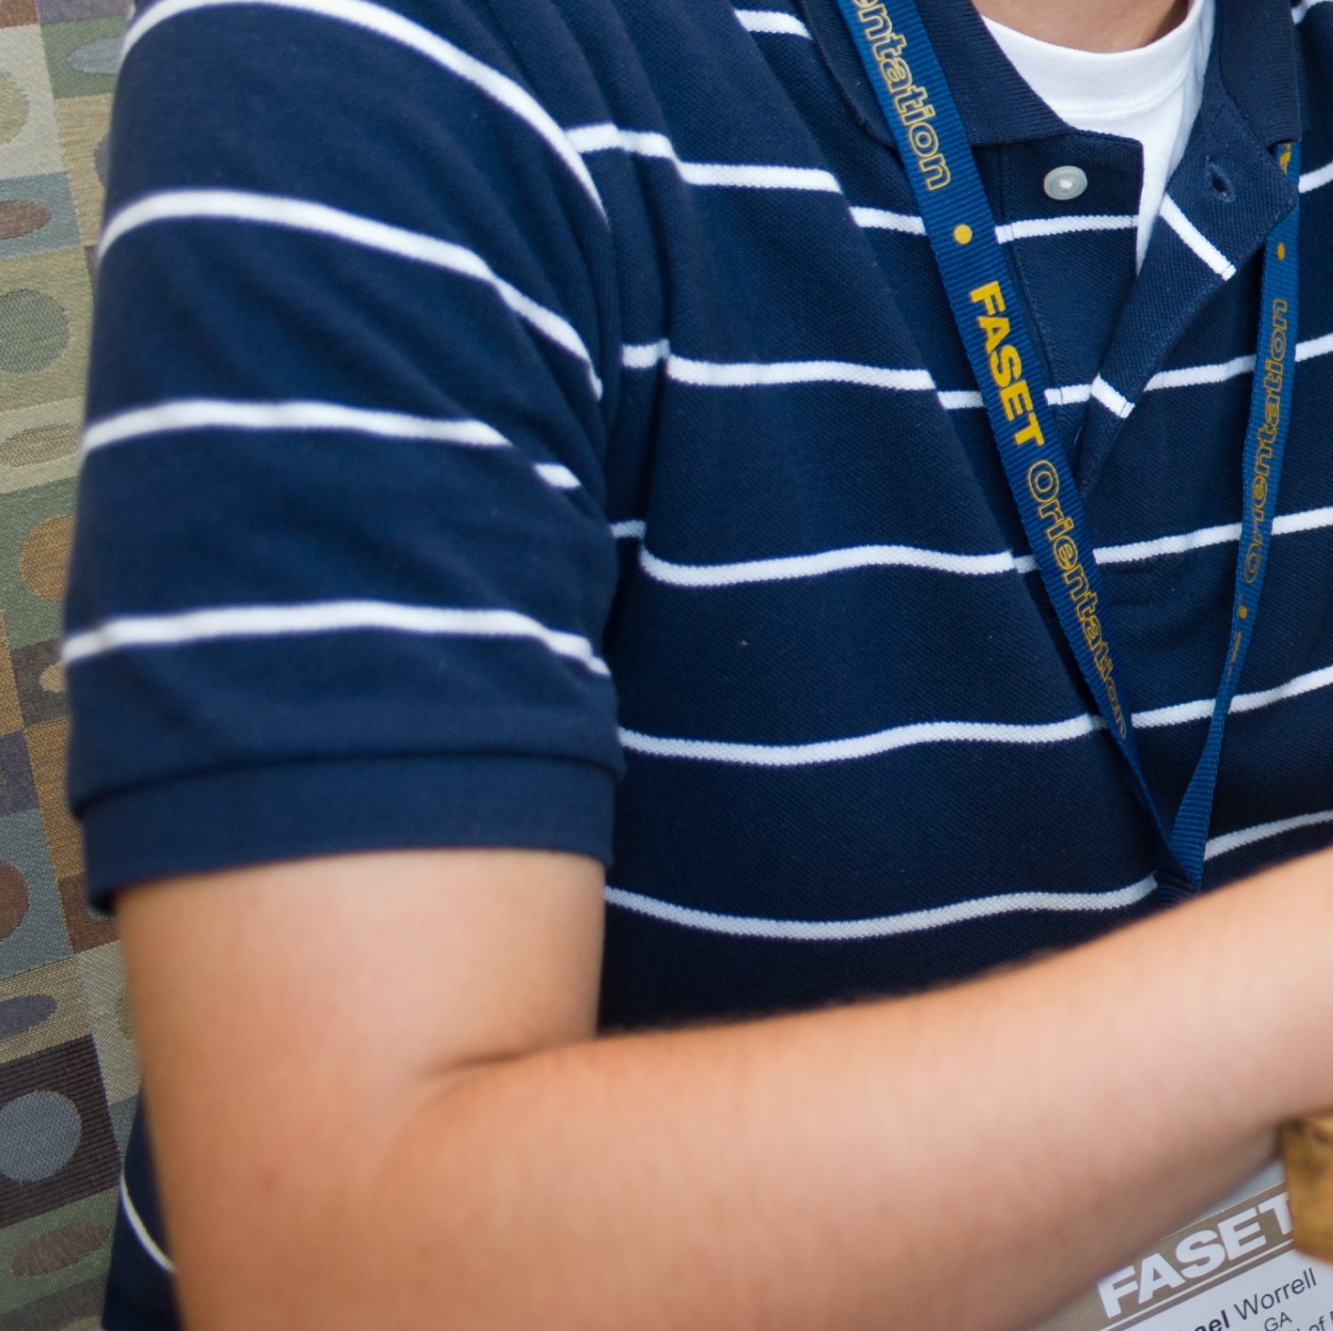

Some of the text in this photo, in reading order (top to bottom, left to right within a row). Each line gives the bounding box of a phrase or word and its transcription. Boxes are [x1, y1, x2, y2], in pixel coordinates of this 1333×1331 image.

[968, 280, 1045, 447] FASET
[1243, 298, 1288, 585] Orientation
[1097, 1192, 1294, 1319] FASET
[1233, 1267, 1318, 1322] Worrell
[1263, 1311, 1293, 1331] GA
